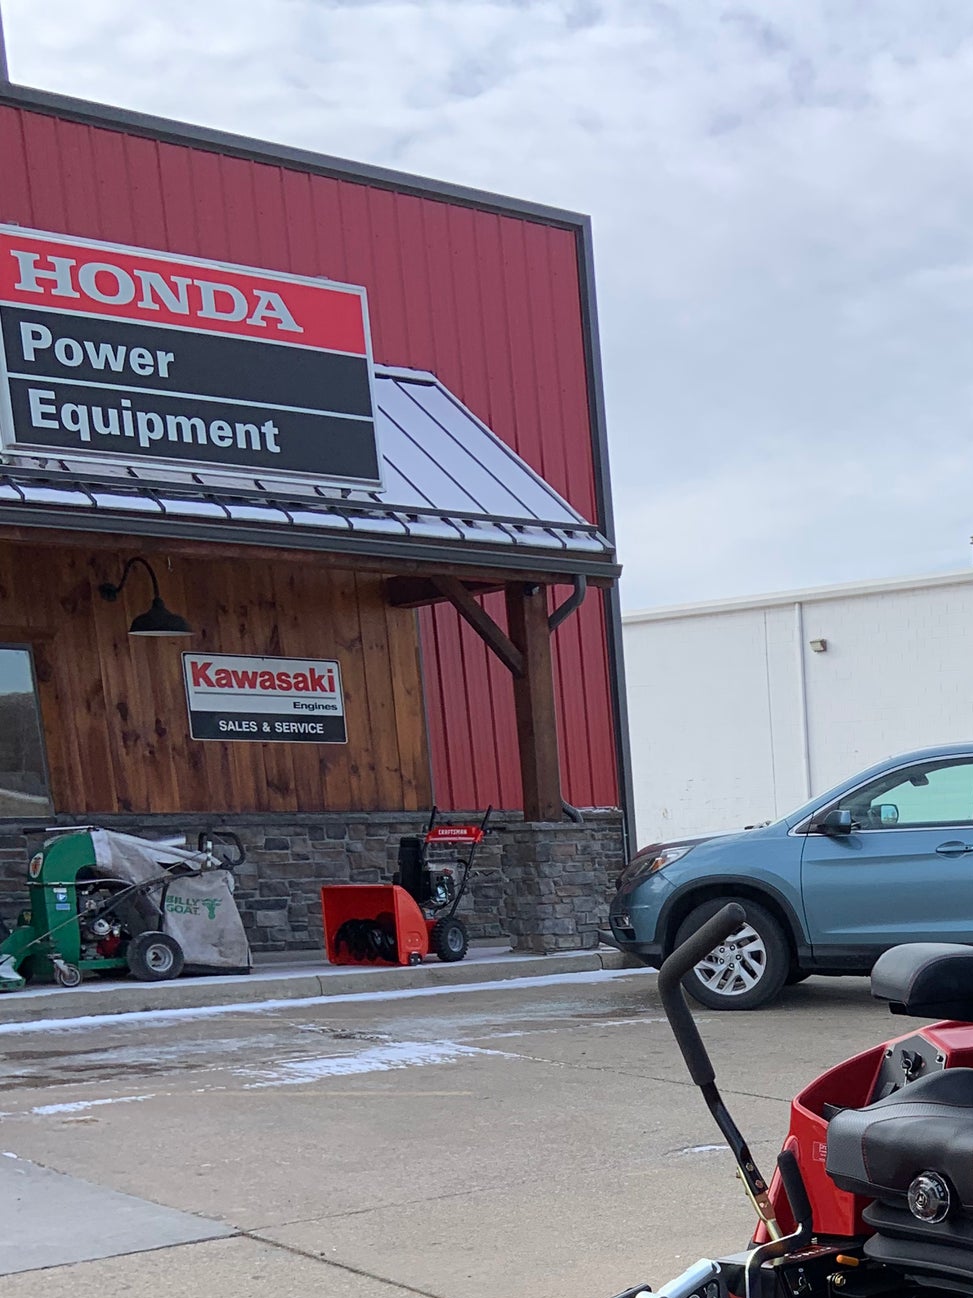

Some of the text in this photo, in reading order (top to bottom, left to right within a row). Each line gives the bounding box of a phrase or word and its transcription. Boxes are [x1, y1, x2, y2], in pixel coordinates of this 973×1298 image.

[10, 249, 304, 333] HONDA
[19, 321, 175, 378] Power
[28, 388, 281, 453] Equipment
[190, 661, 336, 693] Kawasaki
[293, 701, 338, 711] Engines
[218, 720, 325, 734] SALES & SERVICE
[166, 895, 199, 906] BILLY
[166, 903, 200, 915] GOAT
